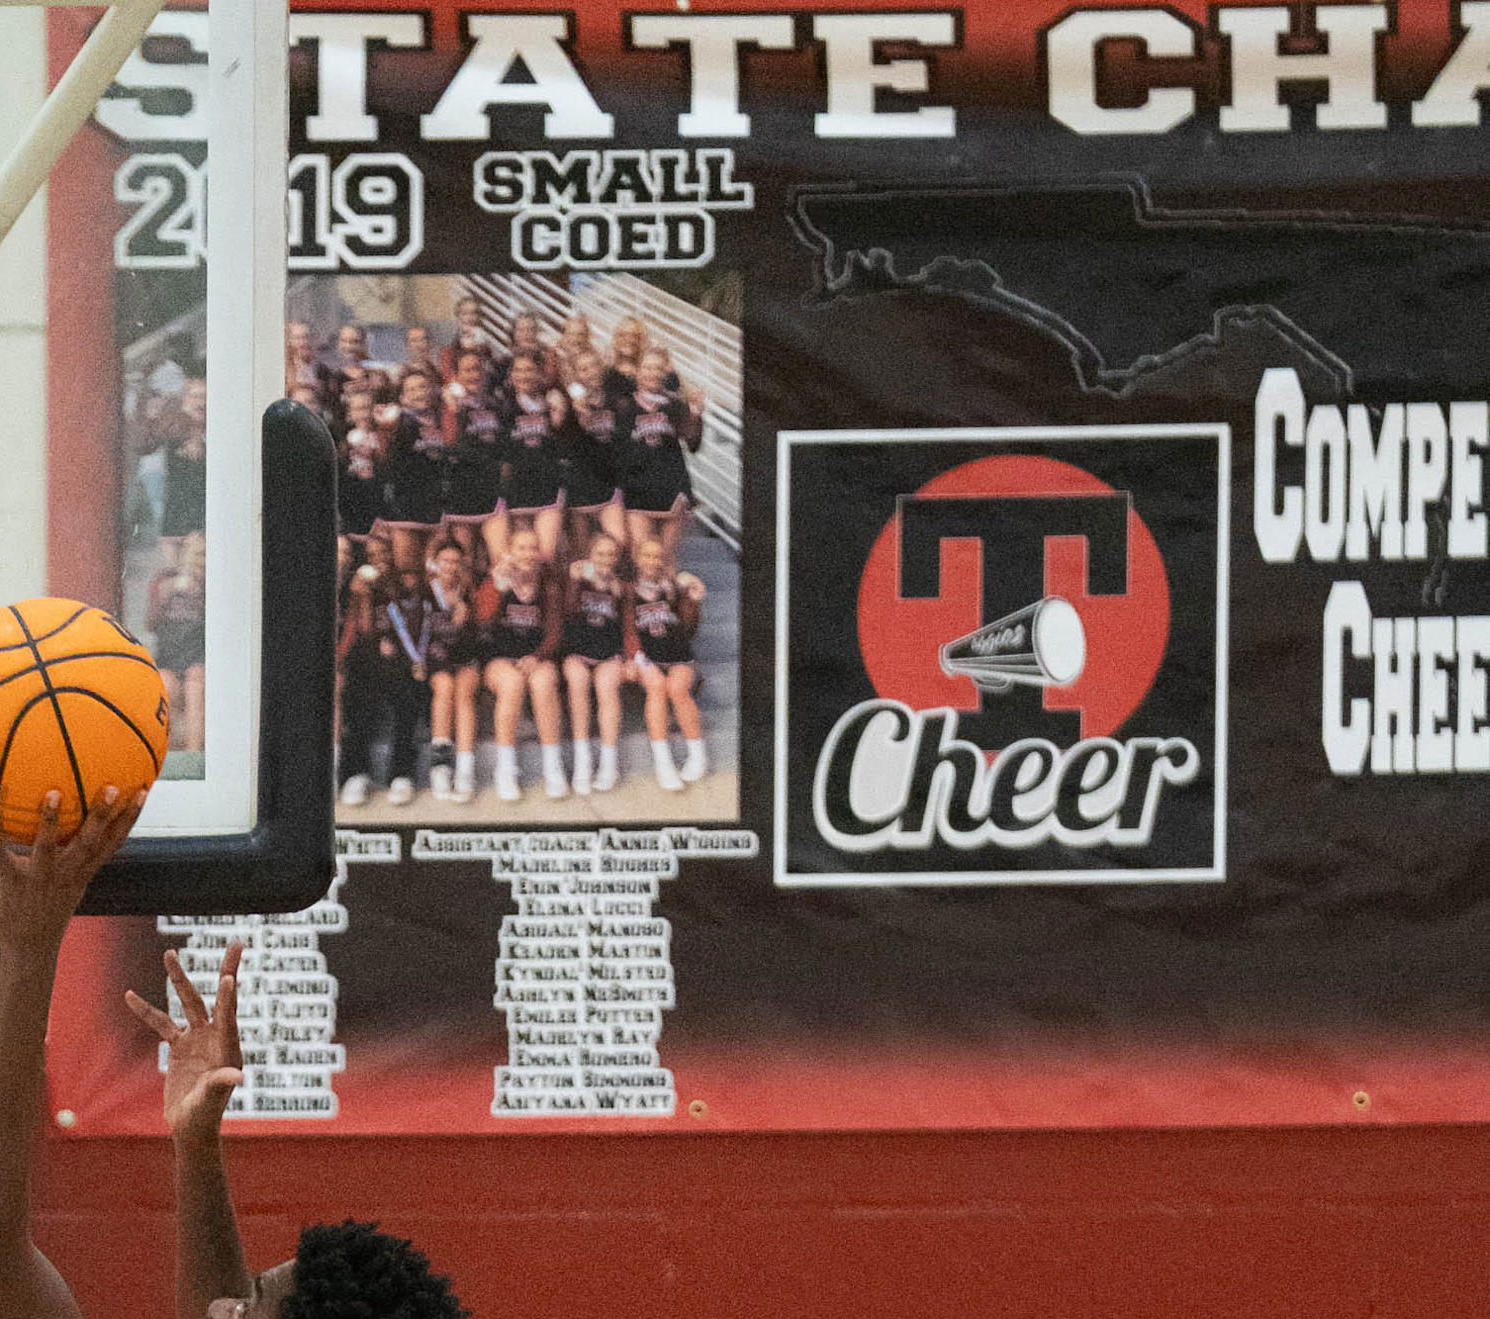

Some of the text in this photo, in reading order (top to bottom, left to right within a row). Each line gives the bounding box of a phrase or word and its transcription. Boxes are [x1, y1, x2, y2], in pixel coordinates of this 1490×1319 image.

[95, 12, 956, 141] STATE
[113, 152, 424, 268] 219
[474, 148, 753, 210] SMALL
[512, 204, 716, 269] COED
[813, 699, 1200, 849] Cheer
